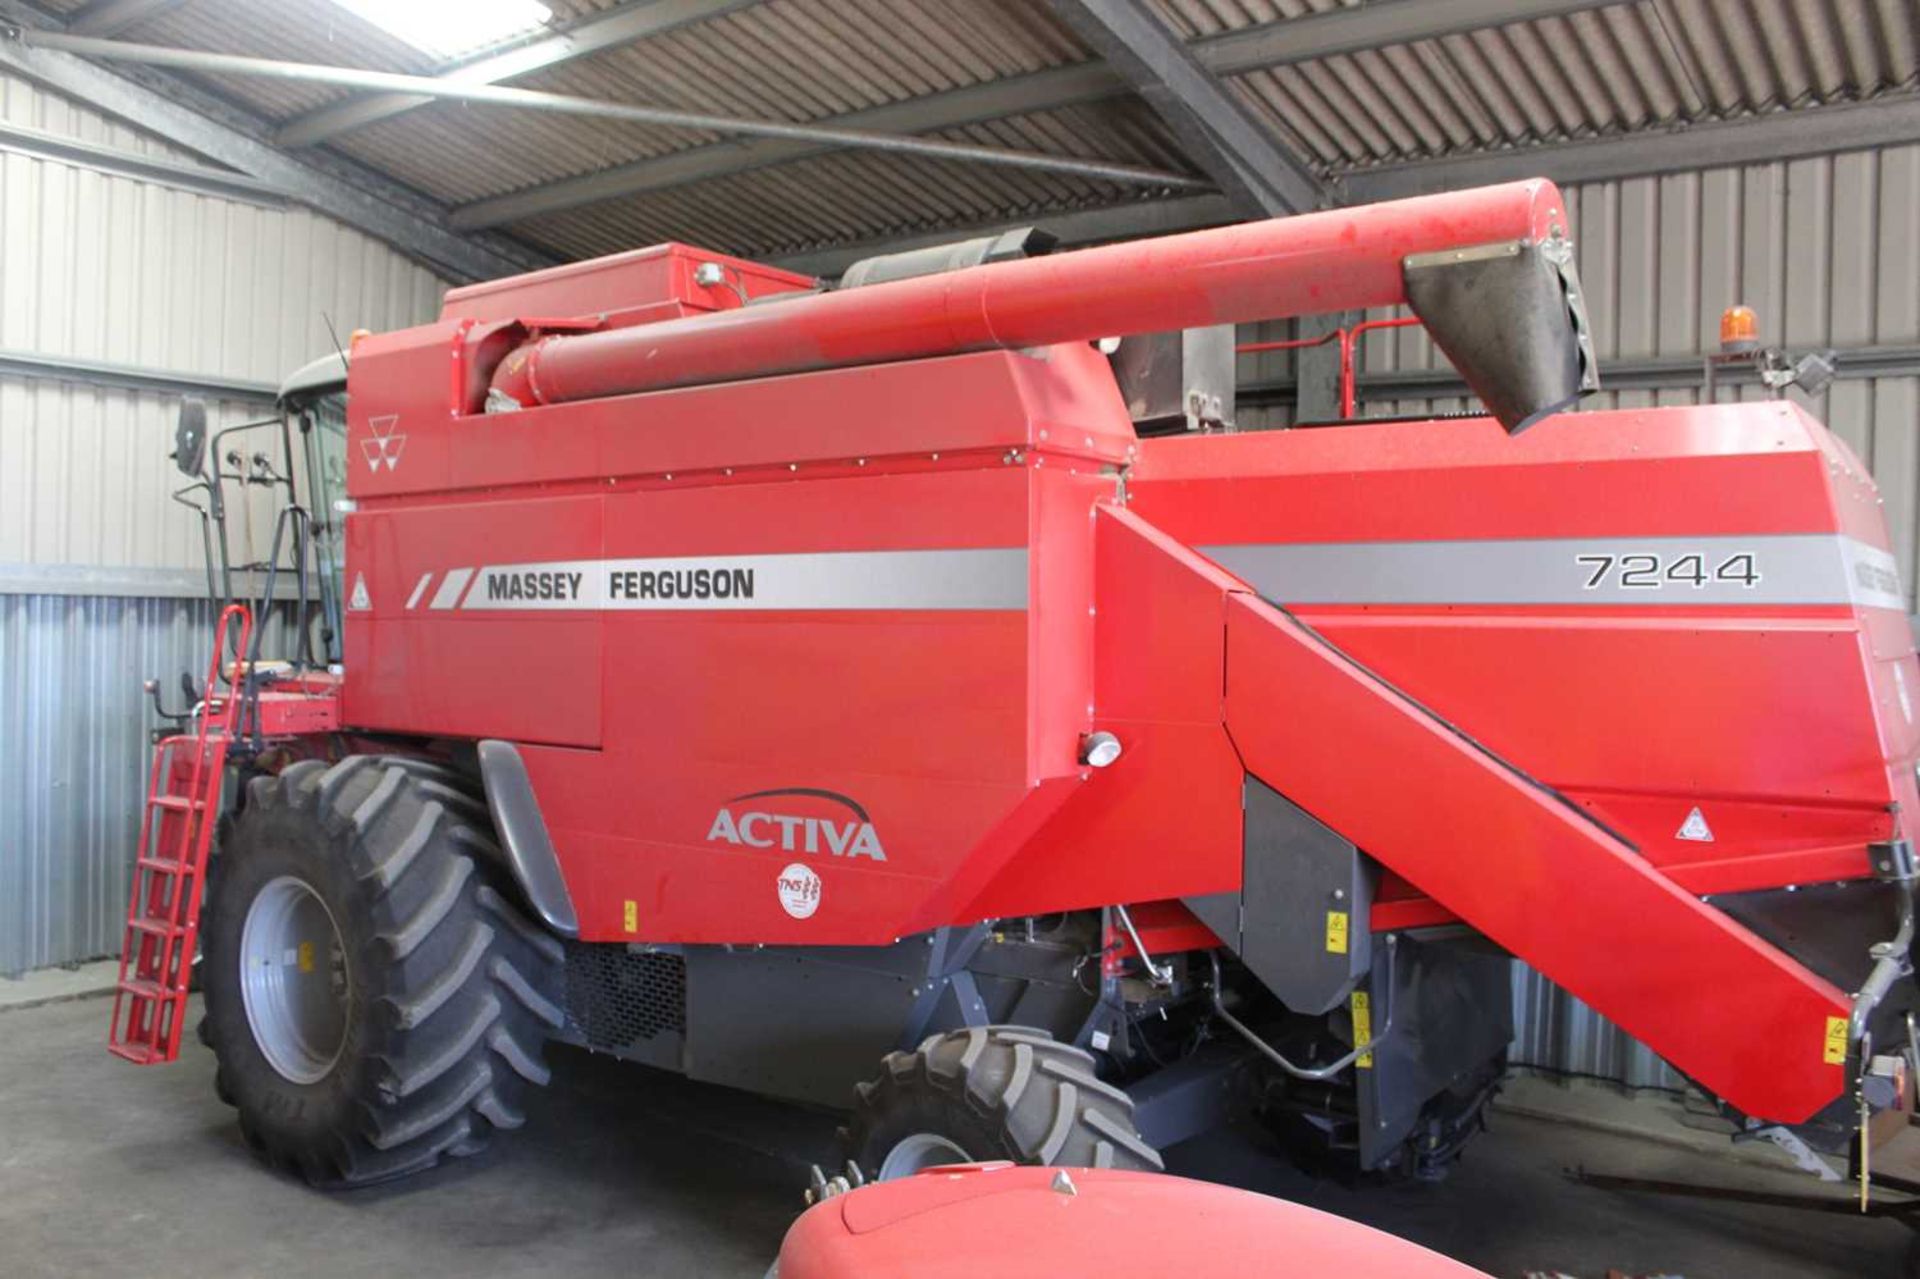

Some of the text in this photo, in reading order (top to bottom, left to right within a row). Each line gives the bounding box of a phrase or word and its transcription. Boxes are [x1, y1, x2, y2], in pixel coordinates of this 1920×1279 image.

[488, 568, 755, 600] MASSEY FERGUSON
[1577, 552, 1761, 590] 7244
[706, 808, 888, 862] ACTIVA
